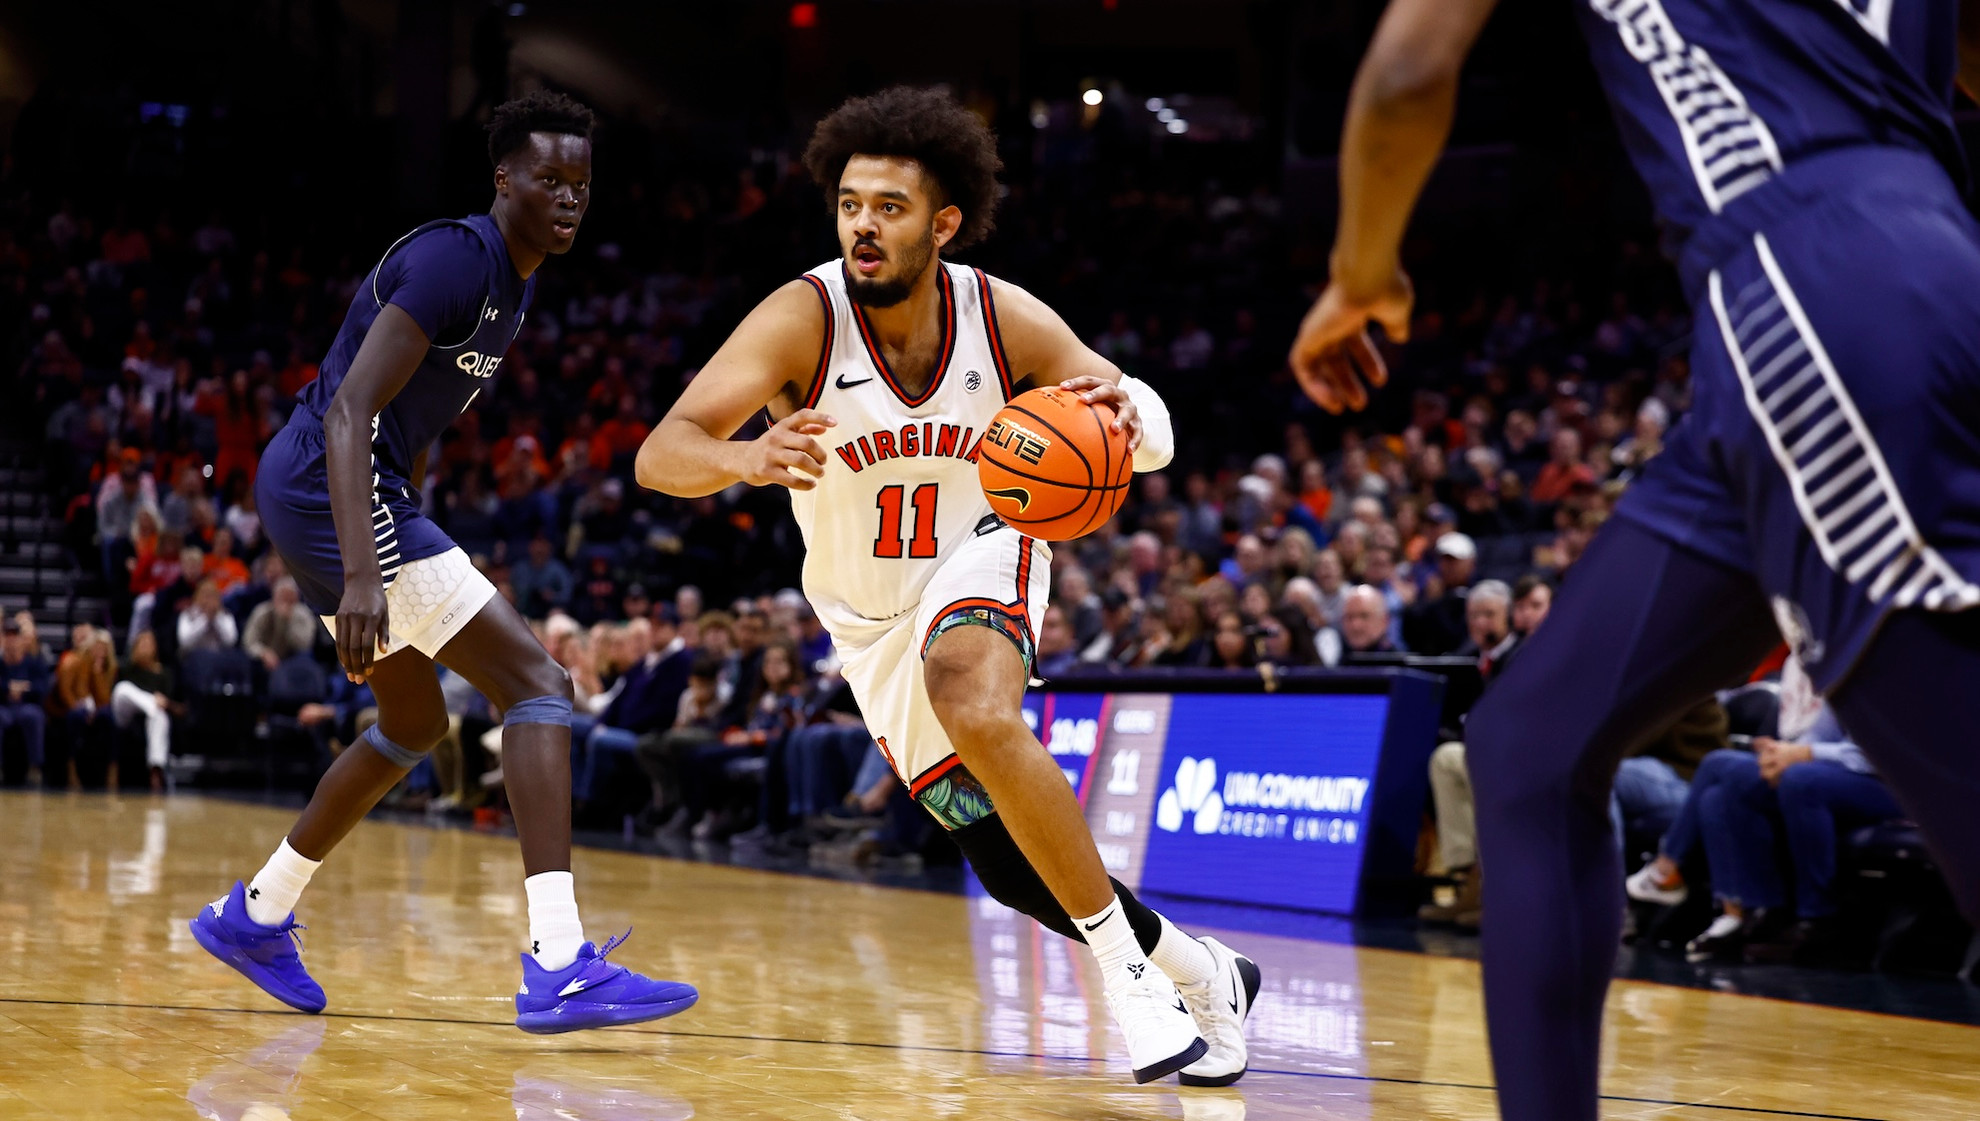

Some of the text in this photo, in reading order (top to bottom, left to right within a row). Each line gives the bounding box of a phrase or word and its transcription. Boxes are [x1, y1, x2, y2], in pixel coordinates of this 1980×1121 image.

[456, 351, 503, 378] QUE
[835, 423, 985, 473] VIRGINIA
[986, 421, 1047, 466] ELITE
[873, 483, 938, 560] 11
[1107, 748, 1140, 796] 11
[1219, 810, 1359, 843] CREDIT UNION
